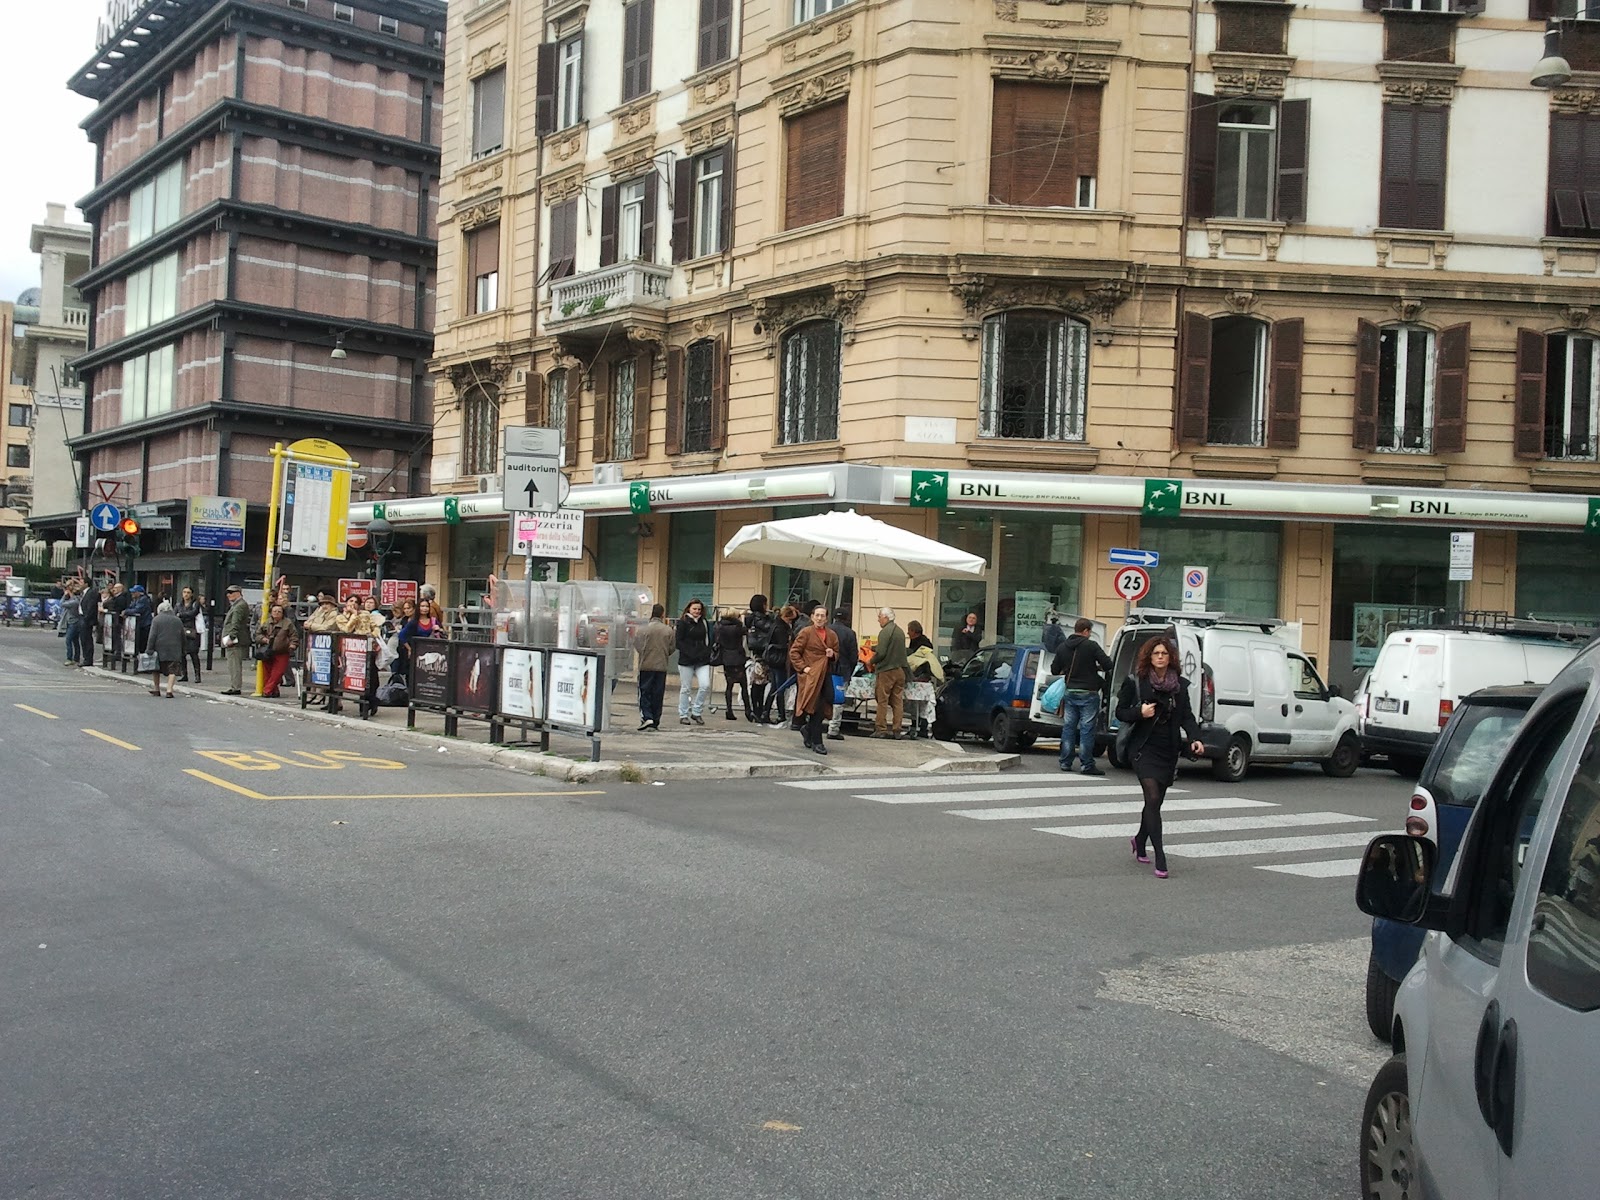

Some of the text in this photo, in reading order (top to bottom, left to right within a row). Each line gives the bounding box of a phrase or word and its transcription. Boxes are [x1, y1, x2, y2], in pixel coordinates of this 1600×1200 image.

[507, 463, 557, 474] auditorium
[648, 488, 673, 502] BNL
[960, 483, 1007, 498] BNL
[1185, 491, 1232, 507] BNL
[387, 508, 403, 518] BNL
[460, 503, 479, 514] BNL
[1409, 500, 1456, 515] BNL
[518, 511, 581, 521] Rstorante
[1123, 575, 1141, 590] 25
[315, 635, 332, 648] OLFO
[508, 677, 523, 690] ESTATE
[557, 681, 575, 695] ESTATE
[193, 749, 408, 771] BUS
